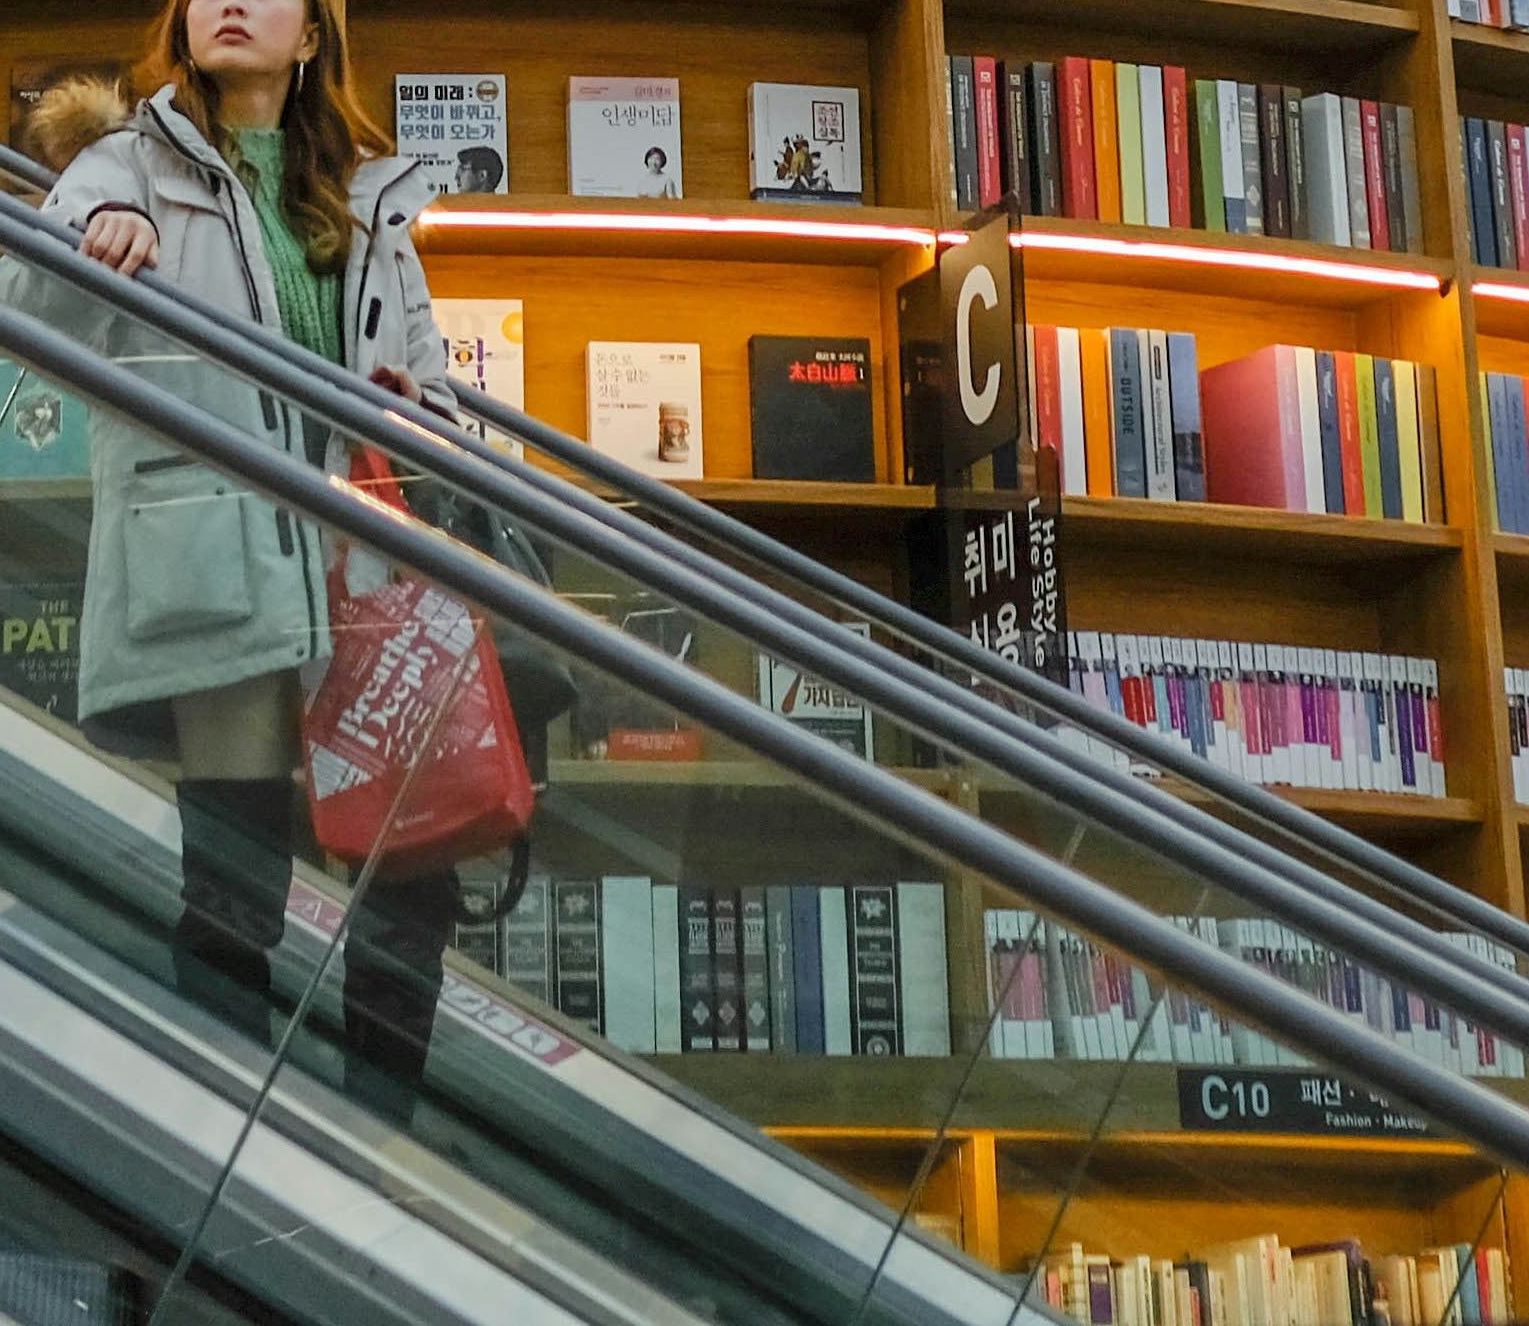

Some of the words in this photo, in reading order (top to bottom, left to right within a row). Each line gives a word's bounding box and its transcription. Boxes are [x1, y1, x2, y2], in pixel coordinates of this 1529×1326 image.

[399, 84, 430, 102] 일의
[399, 104, 445, 124] 무엇이
[449, 103, 502, 126] 바뀌고,
[601, 104, 675, 129] 인생미답
[399, 124, 445, 144] 무엇이
[449, 124, 496, 144] 오는가
[956, 265, 1002, 426] C
[1120, 377, 1137, 438] OUTSIDE
[1026, 496, 1042, 568] Life
[1041, 517, 1058, 634] Hobby
[40, 599, 69, 614] THE
[1029, 574, 1049, 669] Style
[2, 616, 77, 654] PAT
[337, 619, 420, 737] Breathe
[356, 645, 439, 749] Deeply
[1201, 1074, 1271, 1121] C10
[1325, 1111, 1372, 1129] Fashion
